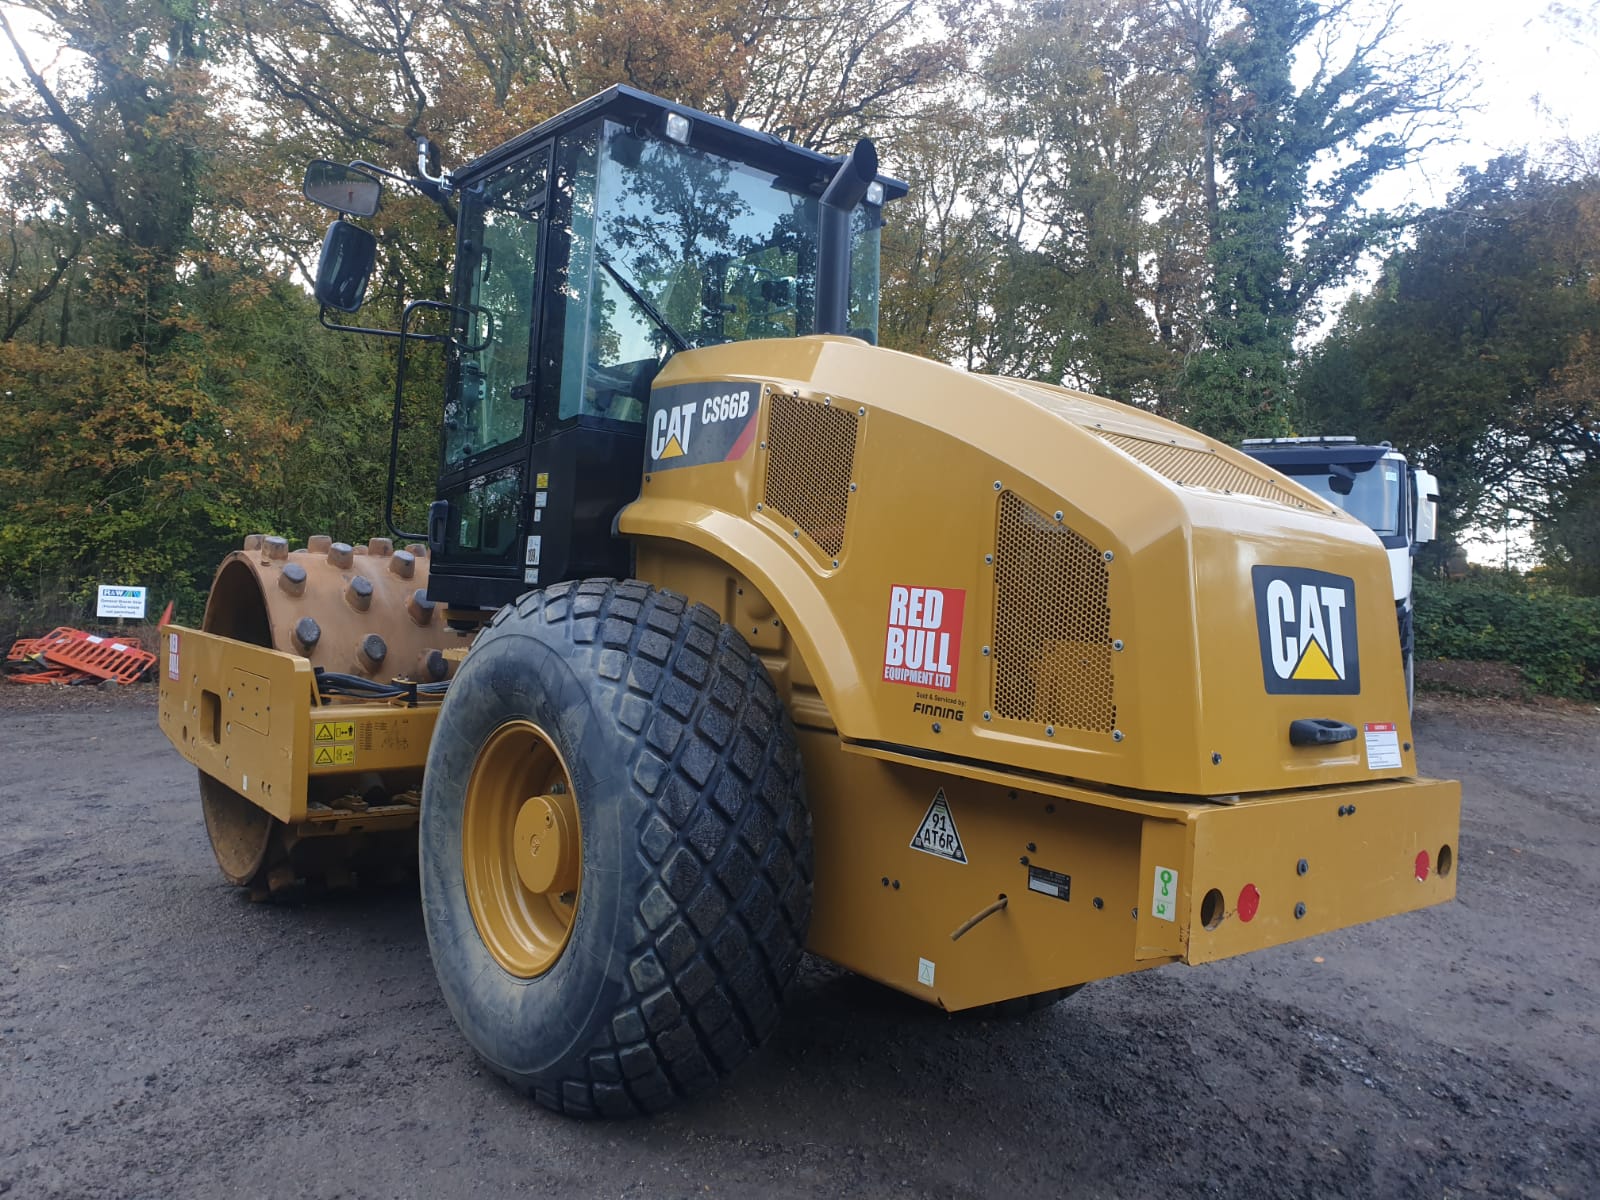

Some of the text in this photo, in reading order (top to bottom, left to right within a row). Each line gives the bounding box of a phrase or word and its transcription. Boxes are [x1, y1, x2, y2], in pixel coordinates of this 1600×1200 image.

[651, 391, 750, 460] CAT CS66B
[889, 586, 944, 629] RED
[1266, 579, 1346, 681] CAT
[885, 626, 952, 674] BULL
[884, 666, 951, 688] EQUIPMENT LTD
[913, 702, 964, 721] FINNING
[932, 813, 947, 832] 91
[923, 828, 954, 851] AT6R
